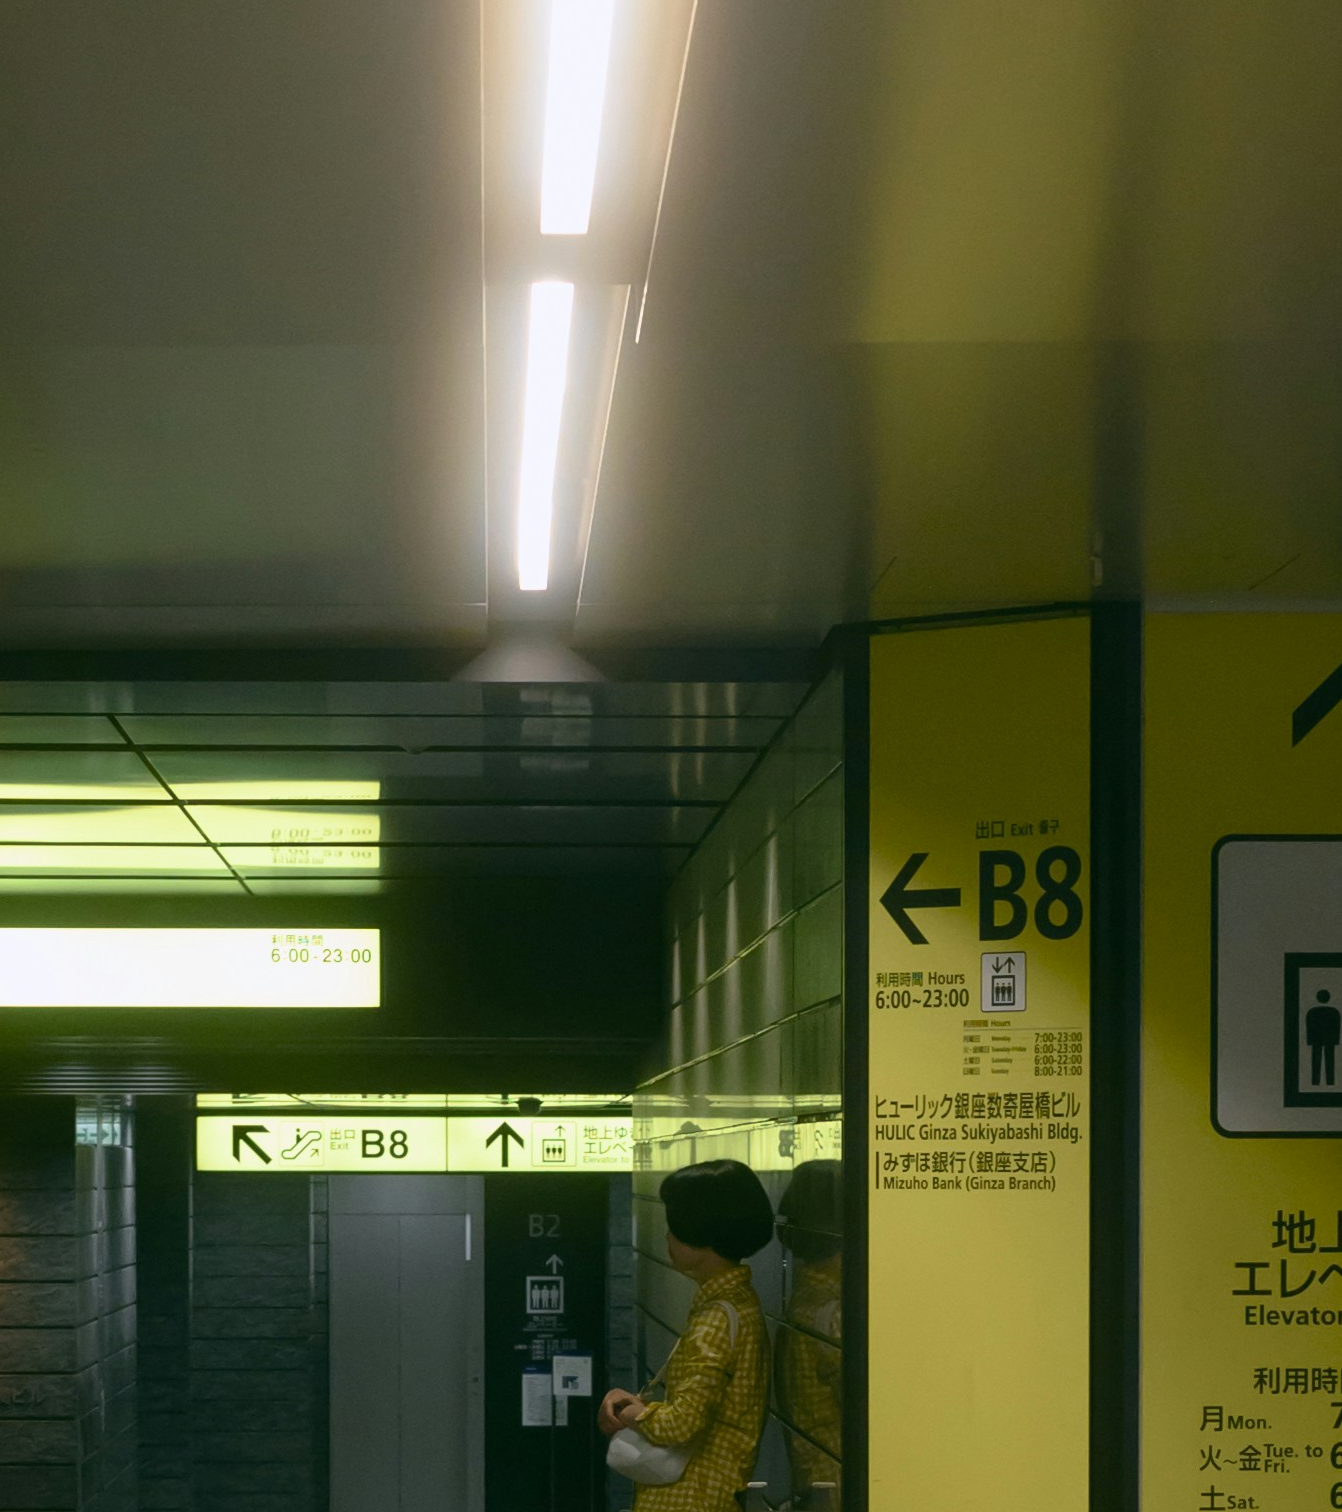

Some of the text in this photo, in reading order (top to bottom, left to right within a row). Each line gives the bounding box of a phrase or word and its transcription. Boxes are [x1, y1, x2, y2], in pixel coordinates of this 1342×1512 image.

[975, 820, 1005, 838] 出口
[1010, 824, 1034, 837] Exit
[979, 845, 1083, 941] B8
[875, 972, 965, 987] 利用時間 Hours
[875, 988, 970, 1009] 6:00~23:00
[1034, 1032, 1083, 1043] 7:00-23:00
[1034, 1043, 1083, 1054] 6:00-23:00
[1034, 1055, 1083, 1065] 6:00-22:00
[1034, 1066, 1083, 1076] 8:00-21:00
[875, 1092, 1081, 1119] ヒューリック銀座数寄屋橋ビル
[330, 1128, 355, 1140] 出口
[583, 1125, 633, 1139] 地上ゆ
[875, 1122, 1083, 1144] HULIC Ginza Sukiyabashi Bldg.
[330, 1142, 349, 1150] Exit
[361, 1129, 409, 1159] B8
[883, 1175, 1056, 1191] Mizuho Bank (Ginza Branch)
[528, 1214, 561, 1237] B2
[1199, 1406, 1223, 1431] 月
[1227, 1415, 1272, 1430] Mon.
[1263, 1443, 1298, 1458] Tue.
[1305, 1444, 1324, 1458] to
[1264, 1459, 1291, 1473] Fri.
[1199, 1485, 1226, 1511] 土
[1227, 1495, 1260, 1510] Sat.
